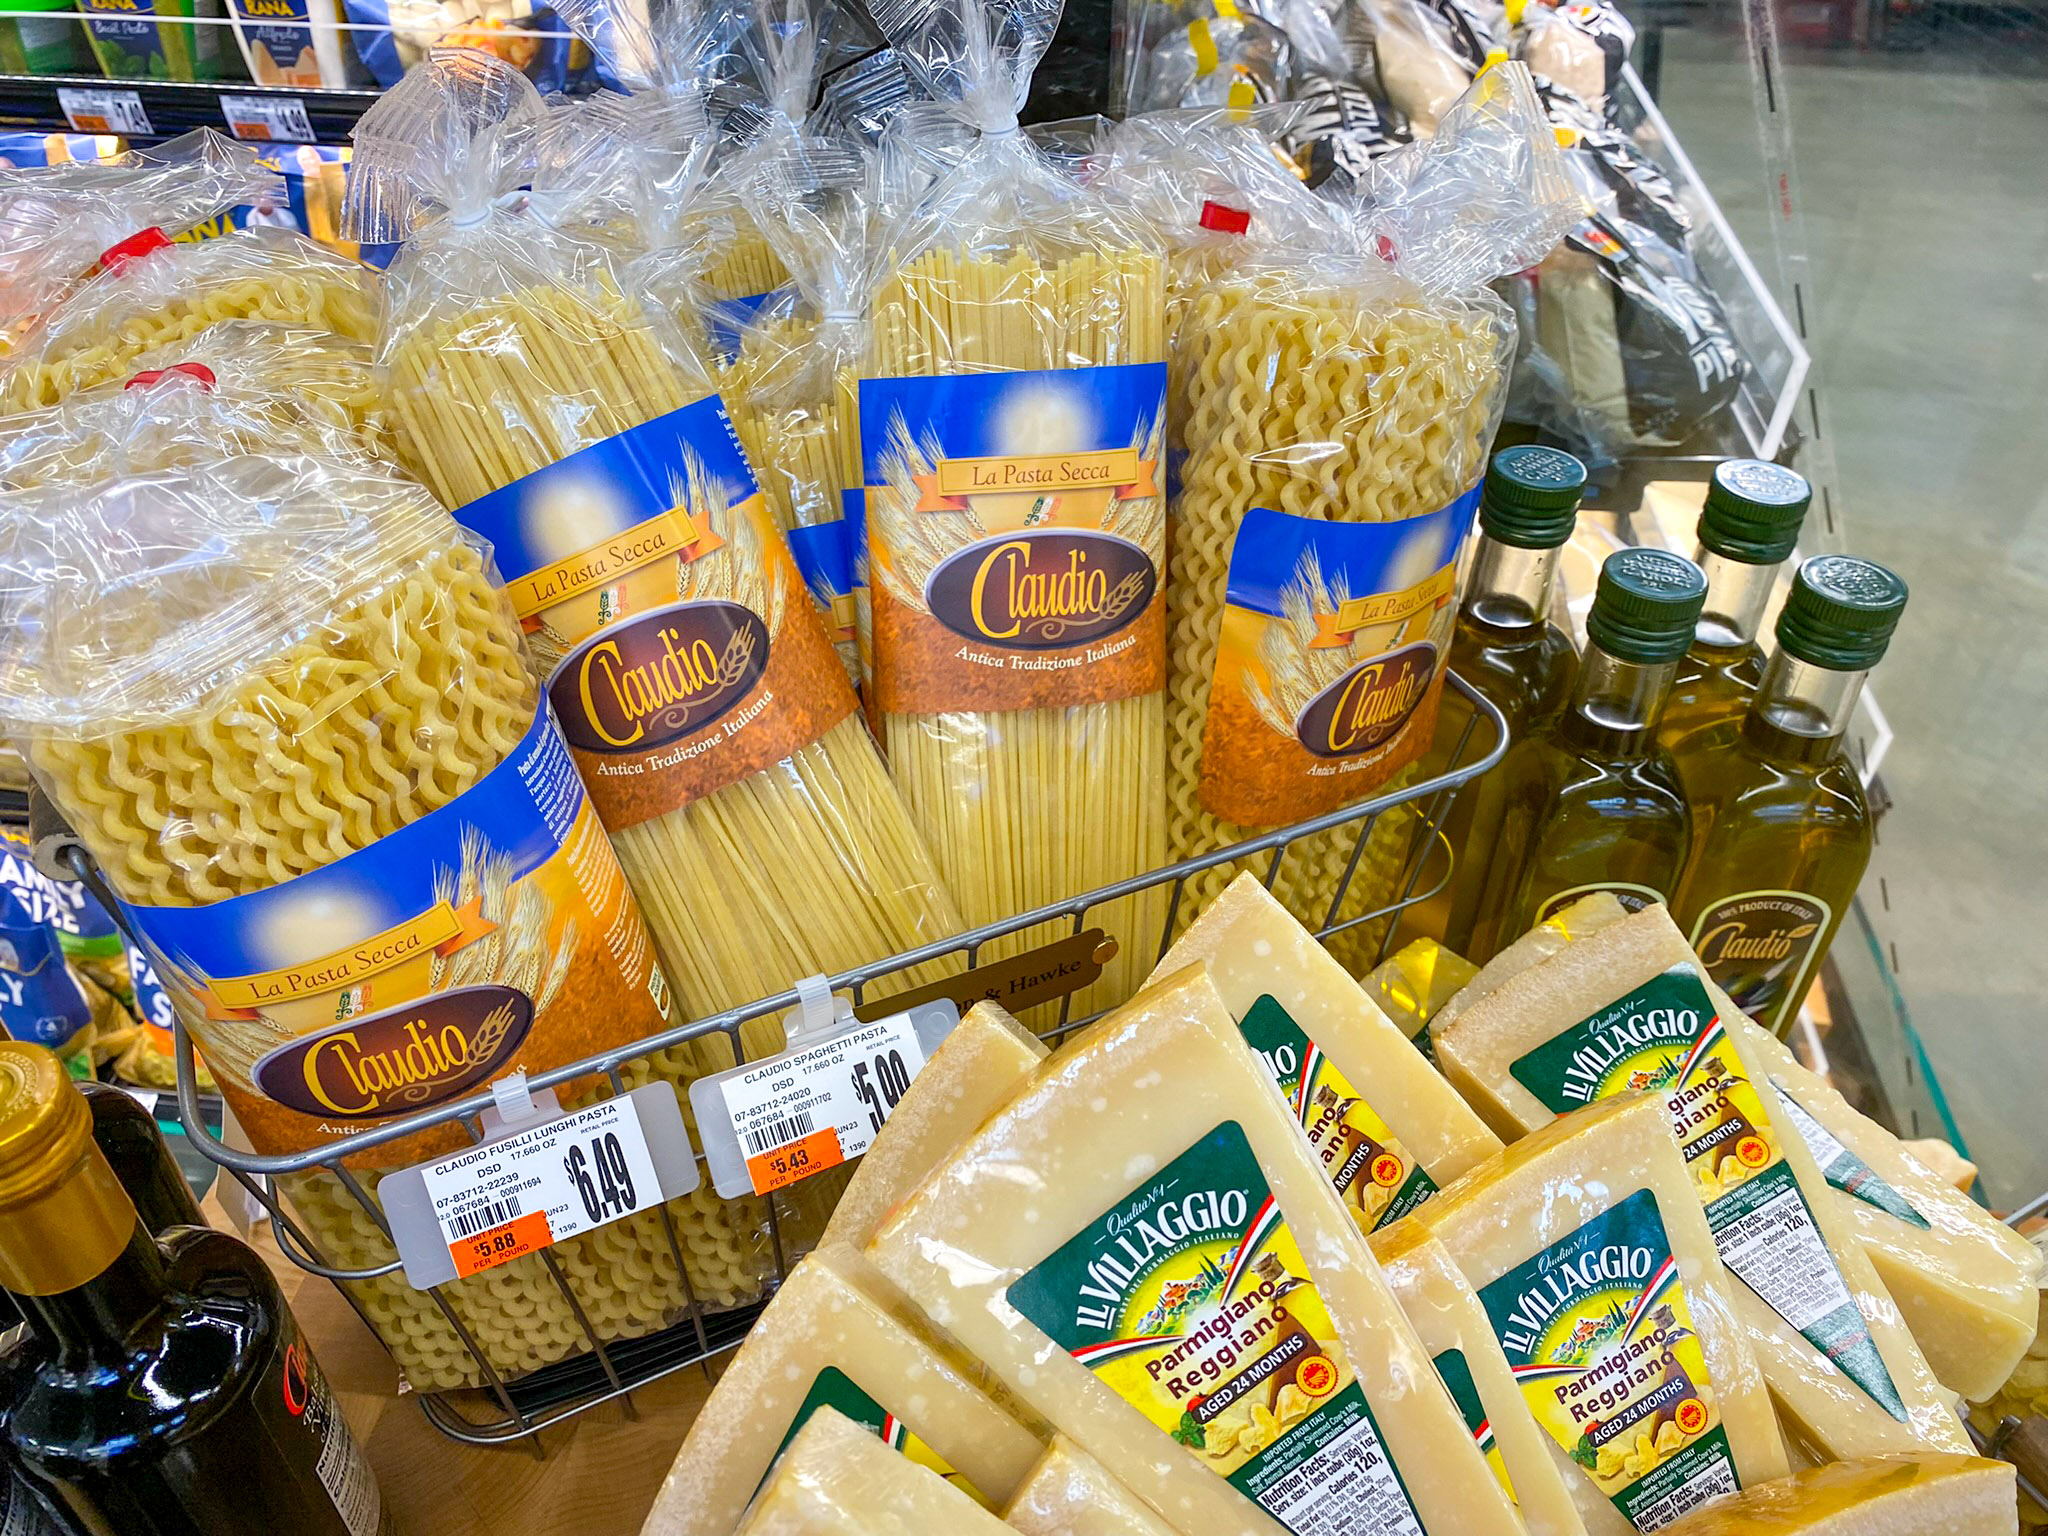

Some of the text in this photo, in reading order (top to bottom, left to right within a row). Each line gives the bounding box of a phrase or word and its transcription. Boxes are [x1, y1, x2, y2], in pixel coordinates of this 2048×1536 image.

[973, 462, 1110, 486] La Pasta Secca
[531, 531, 666, 602] La Pasta Secca
[970, 541, 1107, 639] Claudio
[1360, 603, 1379, 620] La
[1383, 597, 1415, 616] Pasta
[955, 632, 1136, 671] Antica Tradizione Italiana
[579, 626, 719, 748] Claudio
[1328, 660, 1415, 751] Claudio
[596, 688, 774, 777] Antica Tradizione Italiana
[1739, 901, 1782, 914] PRODUCT
[1697, 921, 1792, 969] Claudio
[248, 932, 421, 1000] La Pasta Secca
[1008, 960, 1081, 995] Hawke
[744, 1025, 888, 1084] CLAUDIO SPAGHETTI PASTA
[866, 1034, 901, 1051] RETAIL PRICE
[1565, 1008, 1699, 1083] VILLAGGIO
[303, 1018, 469, 1114] Claudio
[771, 1054, 845, 1092] DSD 17.660 OZ
[734, 1087, 811, 1122] 07-83712-24020
[1562, 1081, 1594, 1102] IL
[1668, 1076, 1720, 1116] giano
[316, 1122, 371, 1135] Antic
[580, 1116, 619, 1135] RETAIL PRICE
[749, 1110, 784, 1130] 067684
[1674, 1095, 1730, 1139] giano
[435, 1104, 617, 1176] CLAUDIO FUSILLI LUNGHI PASTA
[477, 1137, 557, 1179] DSD 17.660 OZ
[763, 1138, 807, 1160] UNIT PRICE
[849, 1141, 867, 1152] 1390
[1683, 1118, 1743, 1159] 24 MONTHS
[563, 1131, 637, 1224] $6.49
[769, 1161, 822, 1186] PER POUND
[770, 1149, 809, 1175] $5.43
[1335, 1143, 1370, 1189] MONTHS
[436, 1172, 519, 1209] 07-83712-22239
[452, 1195, 490, 1216] 067684
[500, 1177, 542, 1198] 000911694
[466, 1221, 514, 1245] UNIT PRICE
[558, 1222, 577, 1234] 1390
[1106, 1199, 1148, 1236] Qualità
[1714, 1212, 1764, 1246] utrition Facts:
[1762, 1228, 1788, 1247] Calories
[473, 1232, 516, 1257] $5.88
[473, 1243, 529, 1269] PER POUND
[1076, 1189, 1247, 1331] IL VILLAGGIO
[1129, 1277, 1143, 1294] DEL
[1143, 1241, 1190, 1277] FORMAGGIO
[1193, 1232, 1239, 1245] ITALIANO
[1502, 1245, 1652, 1355] IL VILLAGGIO
[1605, 1282, 1643, 1290] ITALIANO
[1145, 1280, 1275, 1382] Parmigiano
[1166, 1305, 1288, 1400] Reggiano
[1554, 1328, 1667, 1405] Parmigiano
[1198, 1335, 1303, 1420] AGED 24 MONTHS
[1570, 1351, 1675, 1423] Reggiano
[1315, 1413, 1360, 1448] Contains: Milk
[1594, 1378, 1684, 1444] AGED 24 MONTHS
[1262, 1413, 1326, 1461] IMPORTED FROM ITALY
[1247, 1458, 1285, 1486] Ingredients:
[1262, 1474, 1303, 1506] Nutrition
[1300, 1454, 1330, 1478] Facts:
[1273, 1498, 1292, 1515] Serv.
[1290, 1486, 1308, 1501] size:
[1306, 1482, 1312, 1490] 1
[1311, 1471, 1328, 1486] inch
[1326, 1460, 1344, 1474] cube
[1343, 1446, 1363, 1464] (30g)
[1329, 1450, 1382, 1494] Calories 120,
[1641, 1448, 1696, 1488] IMPORTED FROM ITALY
[1636, 1485, 1694, 1528] Nutrition Facts:
